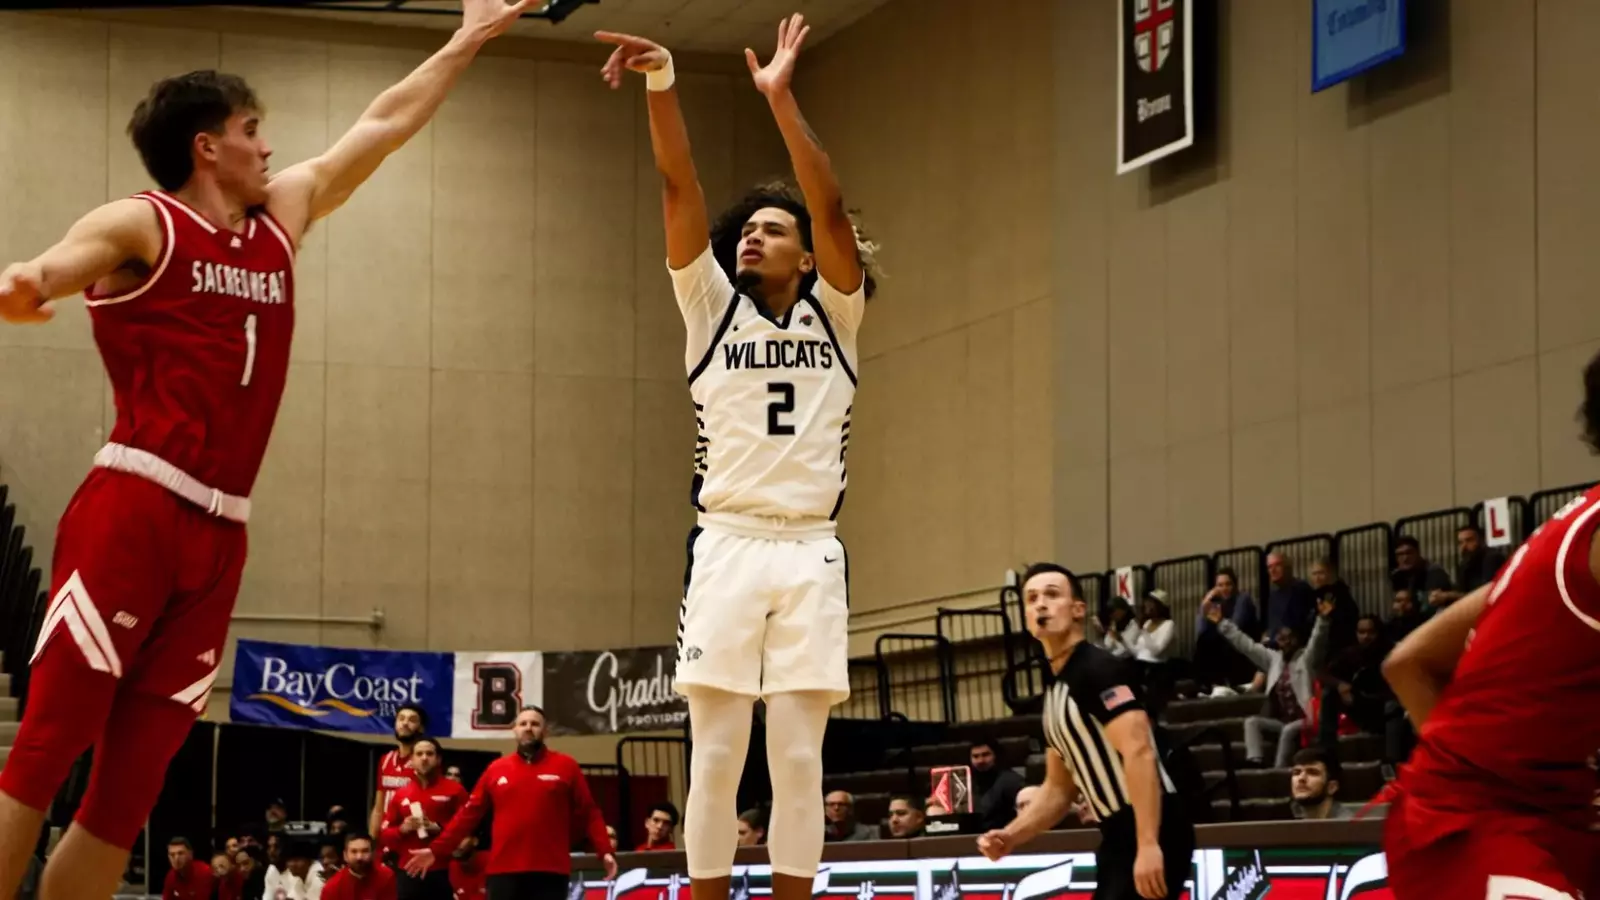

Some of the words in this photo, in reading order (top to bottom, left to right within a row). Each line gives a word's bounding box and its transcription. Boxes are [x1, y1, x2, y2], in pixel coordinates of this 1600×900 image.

[240, 313, 257, 386] 1
[723, 339, 833, 370] WILDCATS
[766, 381, 796, 435] 2
[1489, 506, 1506, 538] L
[1118, 572, 1131, 599] K
[260, 656, 424, 708] BayCoast
[471, 661, 523, 730] B
